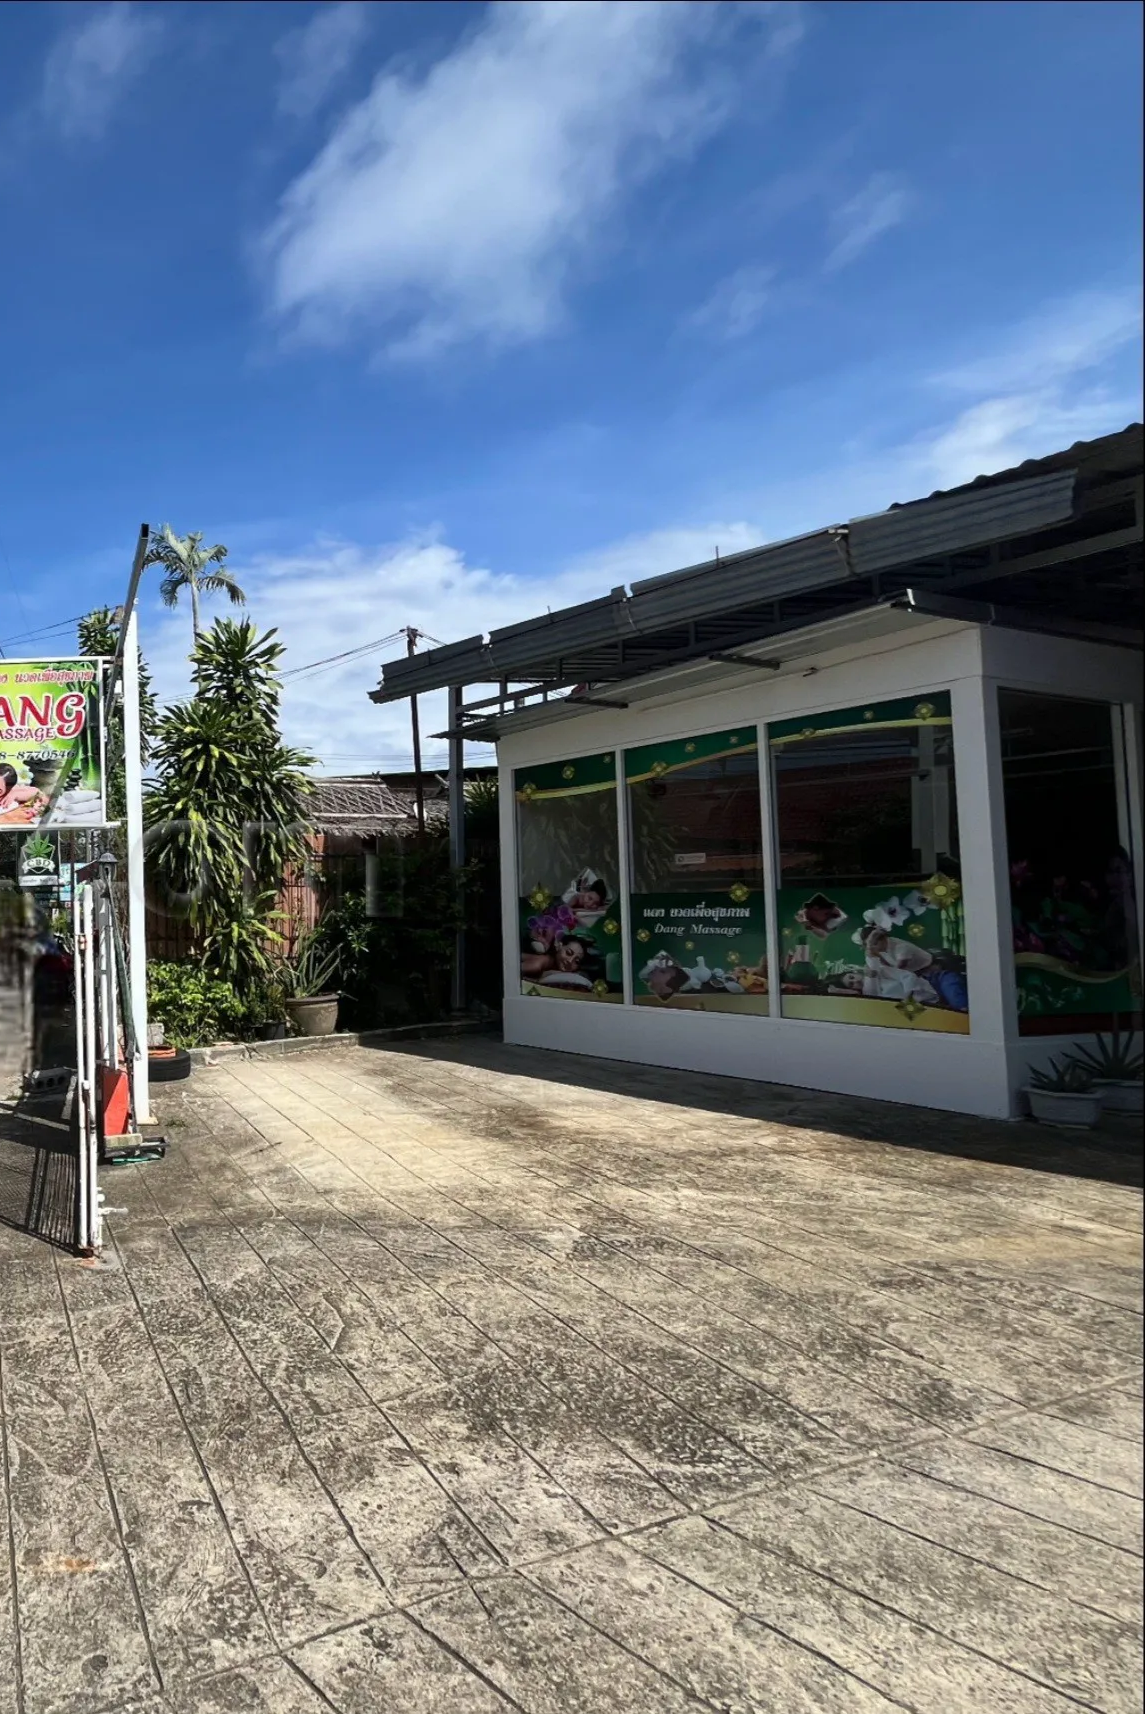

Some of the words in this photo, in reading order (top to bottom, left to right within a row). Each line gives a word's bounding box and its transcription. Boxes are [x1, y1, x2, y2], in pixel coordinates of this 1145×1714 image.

[26, 858, 51, 868] CBD
[655, 923, 686, 937] Dang
[690, 924, 743, 938] Massage
